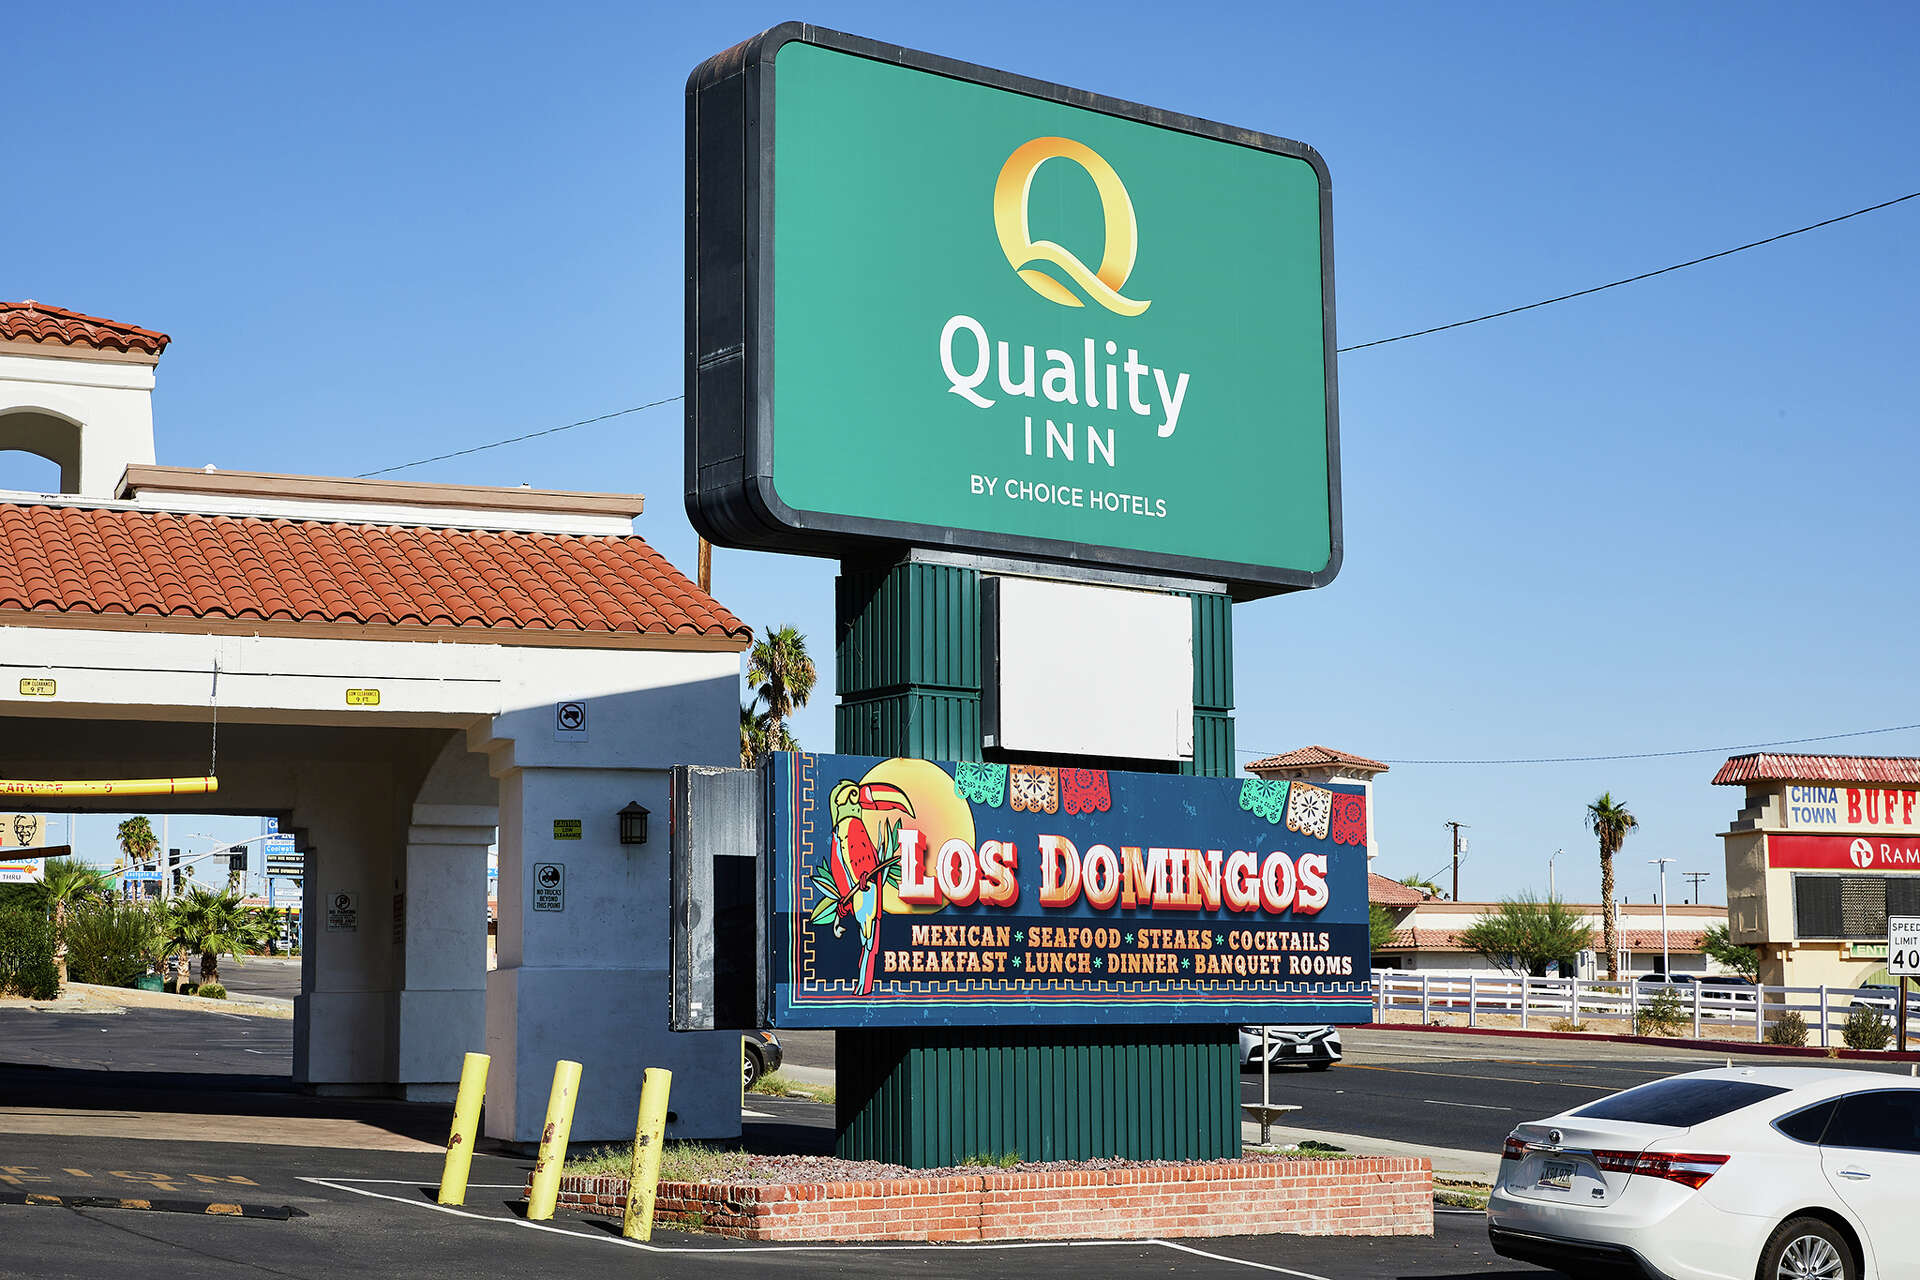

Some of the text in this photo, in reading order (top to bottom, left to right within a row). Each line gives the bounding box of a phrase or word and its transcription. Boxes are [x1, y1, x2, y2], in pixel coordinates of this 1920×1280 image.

[939, 315, 1191, 438] Quality
[1024, 416, 1116, 468] INN
[970, 474, 1168, 518] BY CHOICE HOTELS
[1791, 786, 1838, 804] CHINA
[1846, 788, 1916, 825] BUFF
[1792, 807, 1837, 824] TOWN
[1880, 843, 1920, 864] RAM
[897, 829, 1329, 915] LOS DOMINGOS
[911, 925, 1330, 951] MEXICAN SEAFOOD STEAKS COCKTAILS
[1892, 922, 1920, 932] SPEED
[1895, 937, 1918, 945] LIMIT
[884, 951, 1353, 976] BREAKFAST LUNCH DINNER BANQUET ROOMS
[1892, 949, 1920, 969] 40
